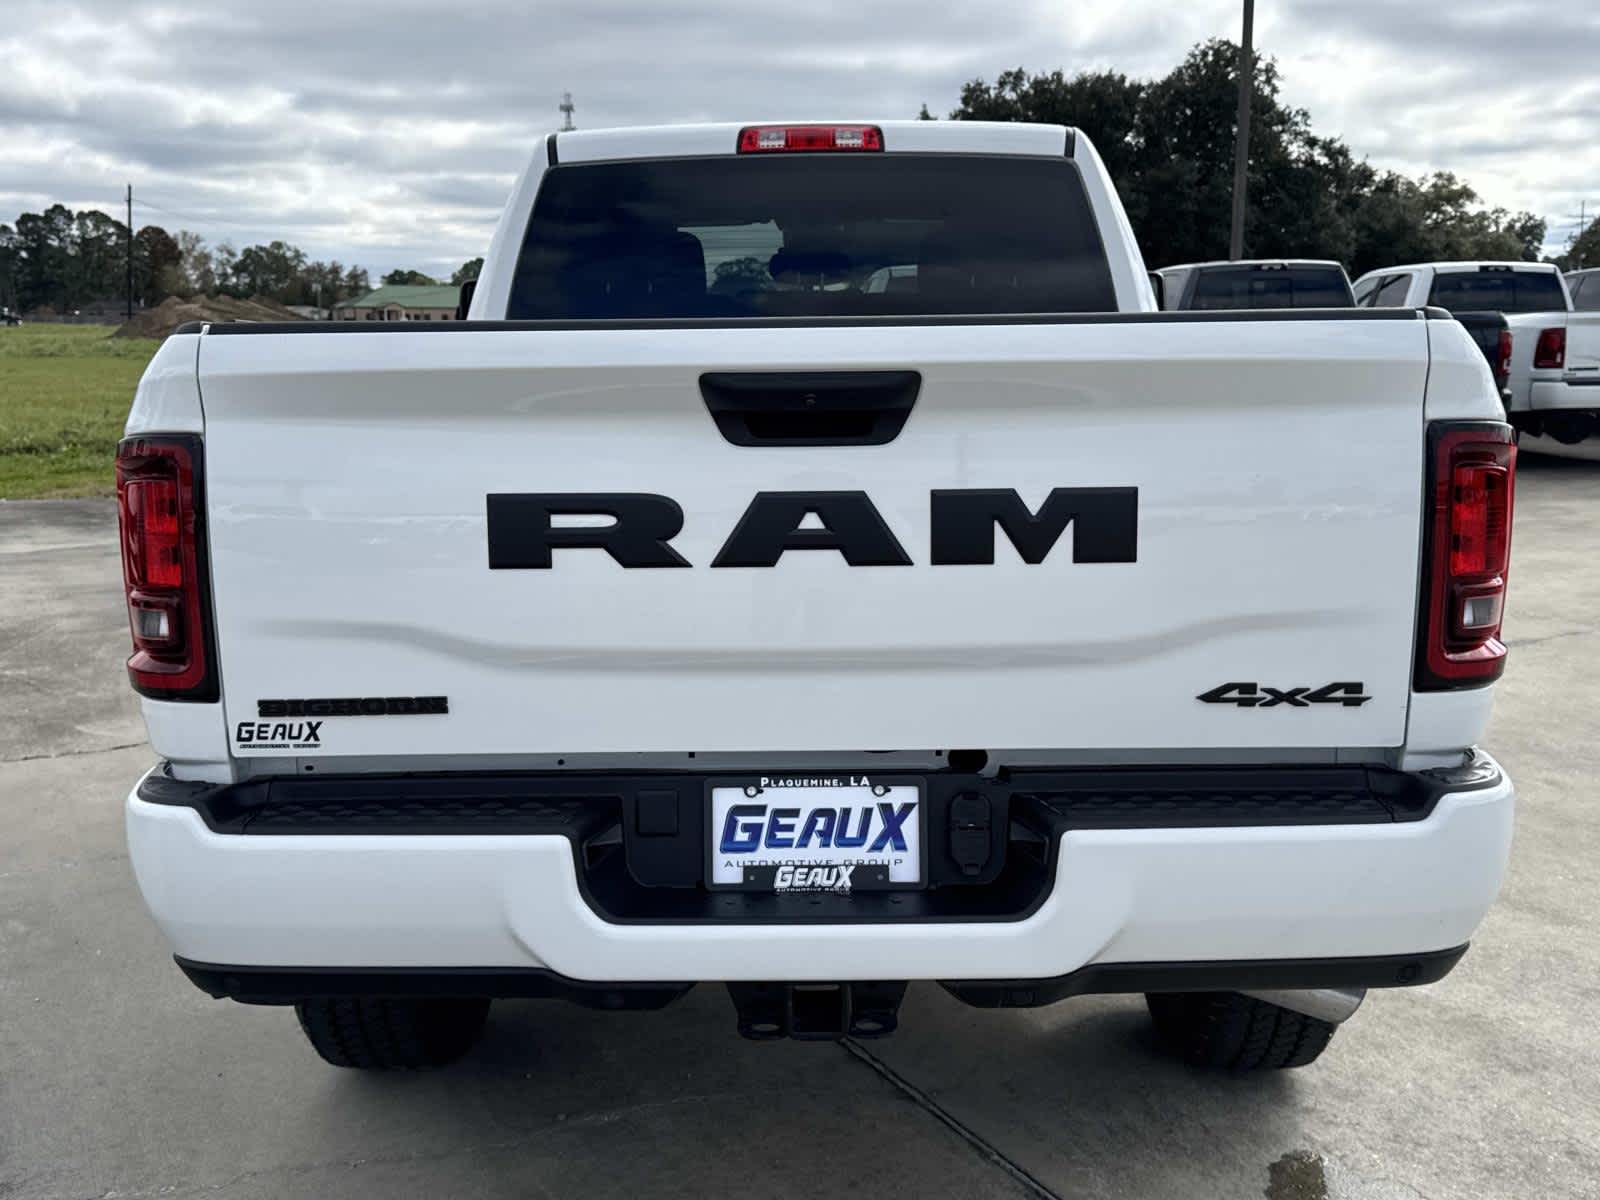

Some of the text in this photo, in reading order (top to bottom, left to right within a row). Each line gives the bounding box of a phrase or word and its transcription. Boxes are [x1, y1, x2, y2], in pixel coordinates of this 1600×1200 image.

[487, 487, 1138, 569] RAM
[236, 721, 323, 742] GEAUX
[850, 776, 870, 786] LA
[719, 802, 918, 854] GEAUX
[724, 859, 833, 868] AUTOMOTIVE
[774, 866, 855, 888] GEAUX
